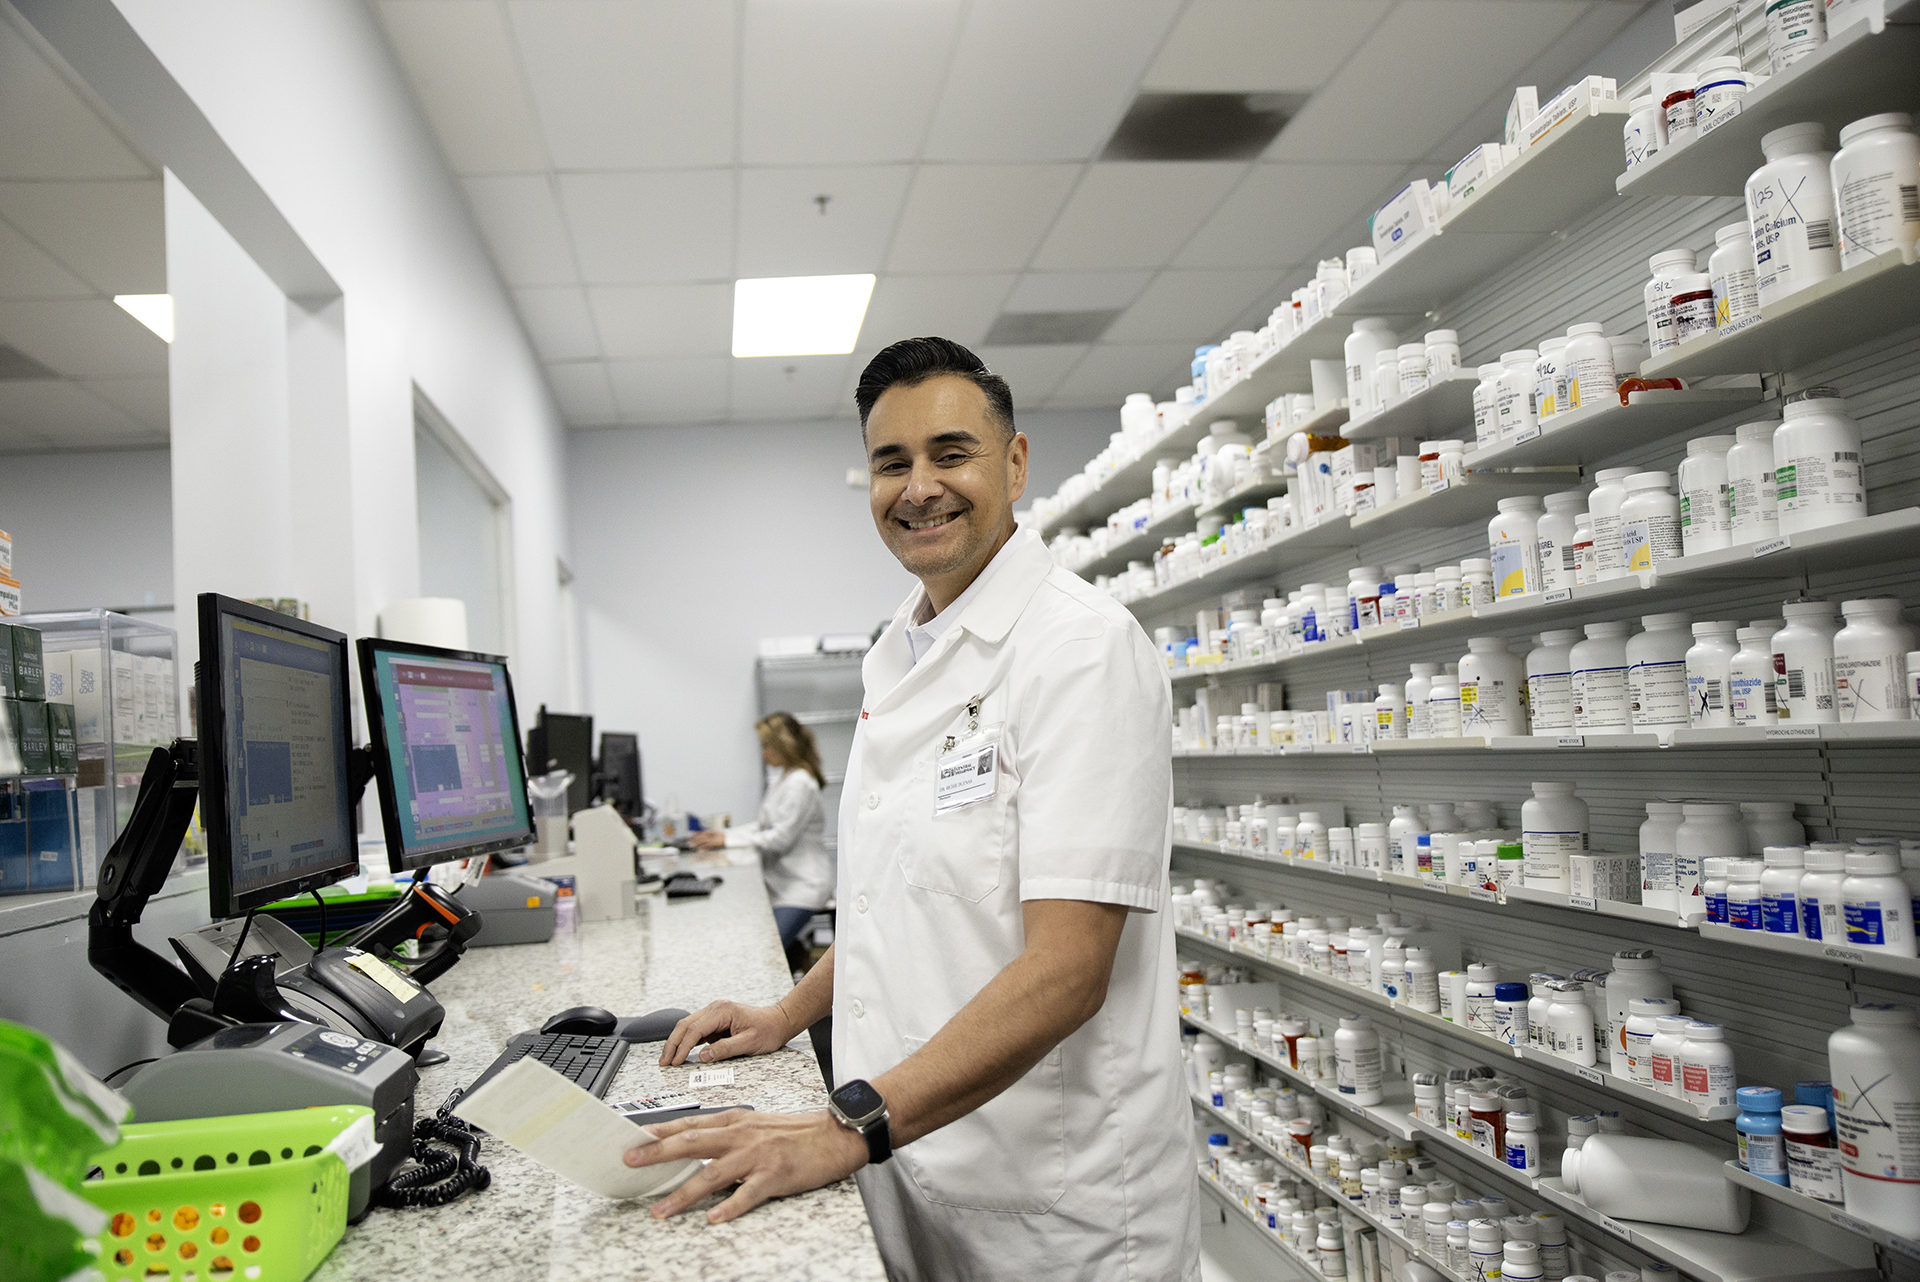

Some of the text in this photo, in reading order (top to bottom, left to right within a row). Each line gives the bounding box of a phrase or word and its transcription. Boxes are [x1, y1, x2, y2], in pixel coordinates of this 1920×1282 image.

[1778, 3, 1815, 18] Amlodipine
[1782, 12, 1811, 24] Besylate
[1702, 107, 1736, 133] AMLODIPINE
[1765, 216, 1797, 233] Calcium
[1766, 231, 1780, 245] USP
[1719, 313, 1762, 337] ATORVASTATIN
[1755, 540, 1785, 554] GABAPENTIN
[1545, 592, 1566, 603] MORE STOCK
[19, 664, 43, 678] BARLEY
[47, 672, 57, 697] Snow
[79, 669, 89, 695] Snow
[87, 671, 95, 693] caps
[1742, 687, 1752, 695] USP
[23, 741, 48, 753] BARLEY
[54, 742, 76, 753] BARLEY
[1571, 898, 1592, 908] MORE STOCK
[1578, 1069, 1599, 1082] MORE STOCK
